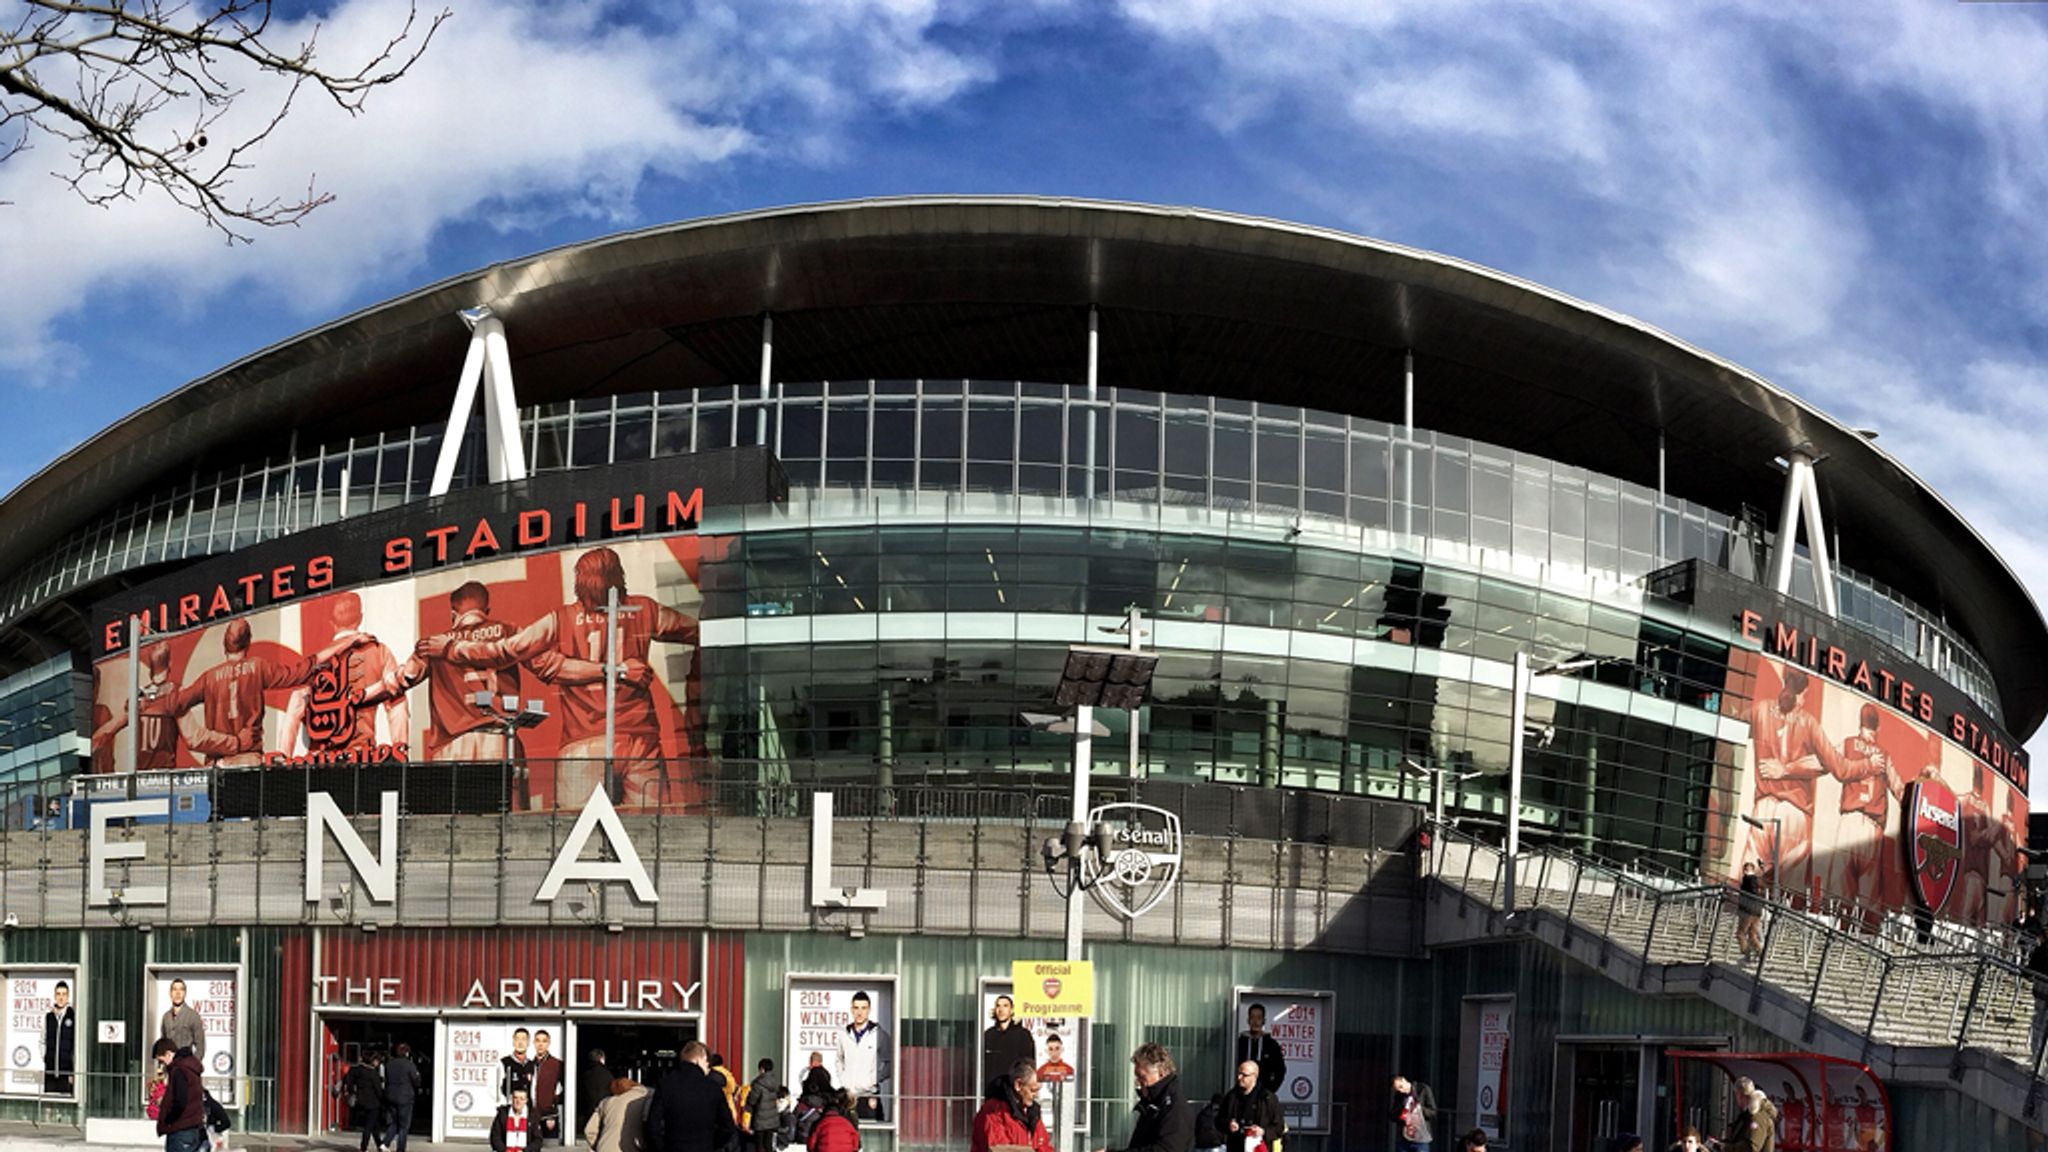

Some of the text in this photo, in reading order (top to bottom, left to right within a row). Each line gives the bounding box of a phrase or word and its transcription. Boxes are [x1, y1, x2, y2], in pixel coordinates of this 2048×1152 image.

[384, 487, 703, 571] STADIUM
[1741, 609, 2027, 791] EMIRATES STADIUM
[1921, 796, 1959, 831] Arsenal
[1112, 826, 1169, 844] rsenal
[1034, 964, 1072, 976] Official
[14, 980, 37, 994] 2014
[319, 976, 701, 1011] THE ARMOURY
[14, 998, 51, 1012] WINTER
[800, 991, 831, 1005] 2014
[192, 1000, 235, 1014] WINTER
[1022, 1002, 1083, 1015] Programme
[1288, 1005, 1315, 1020] 2014
[13, 1015, 42, 1030] STYLE
[201, 1018, 235, 1034] STYLE
[800, 1012, 849, 1026] WINTER
[454, 1030, 481, 1044] 2014
[800, 1031, 838, 1046] STYLE
[1271, 1023, 1315, 1040] WINTER
[454, 1049, 499, 1063] WINTER
[1281, 1042, 1313, 1058] STYLE
[452, 1067, 488, 1082] STYLE
